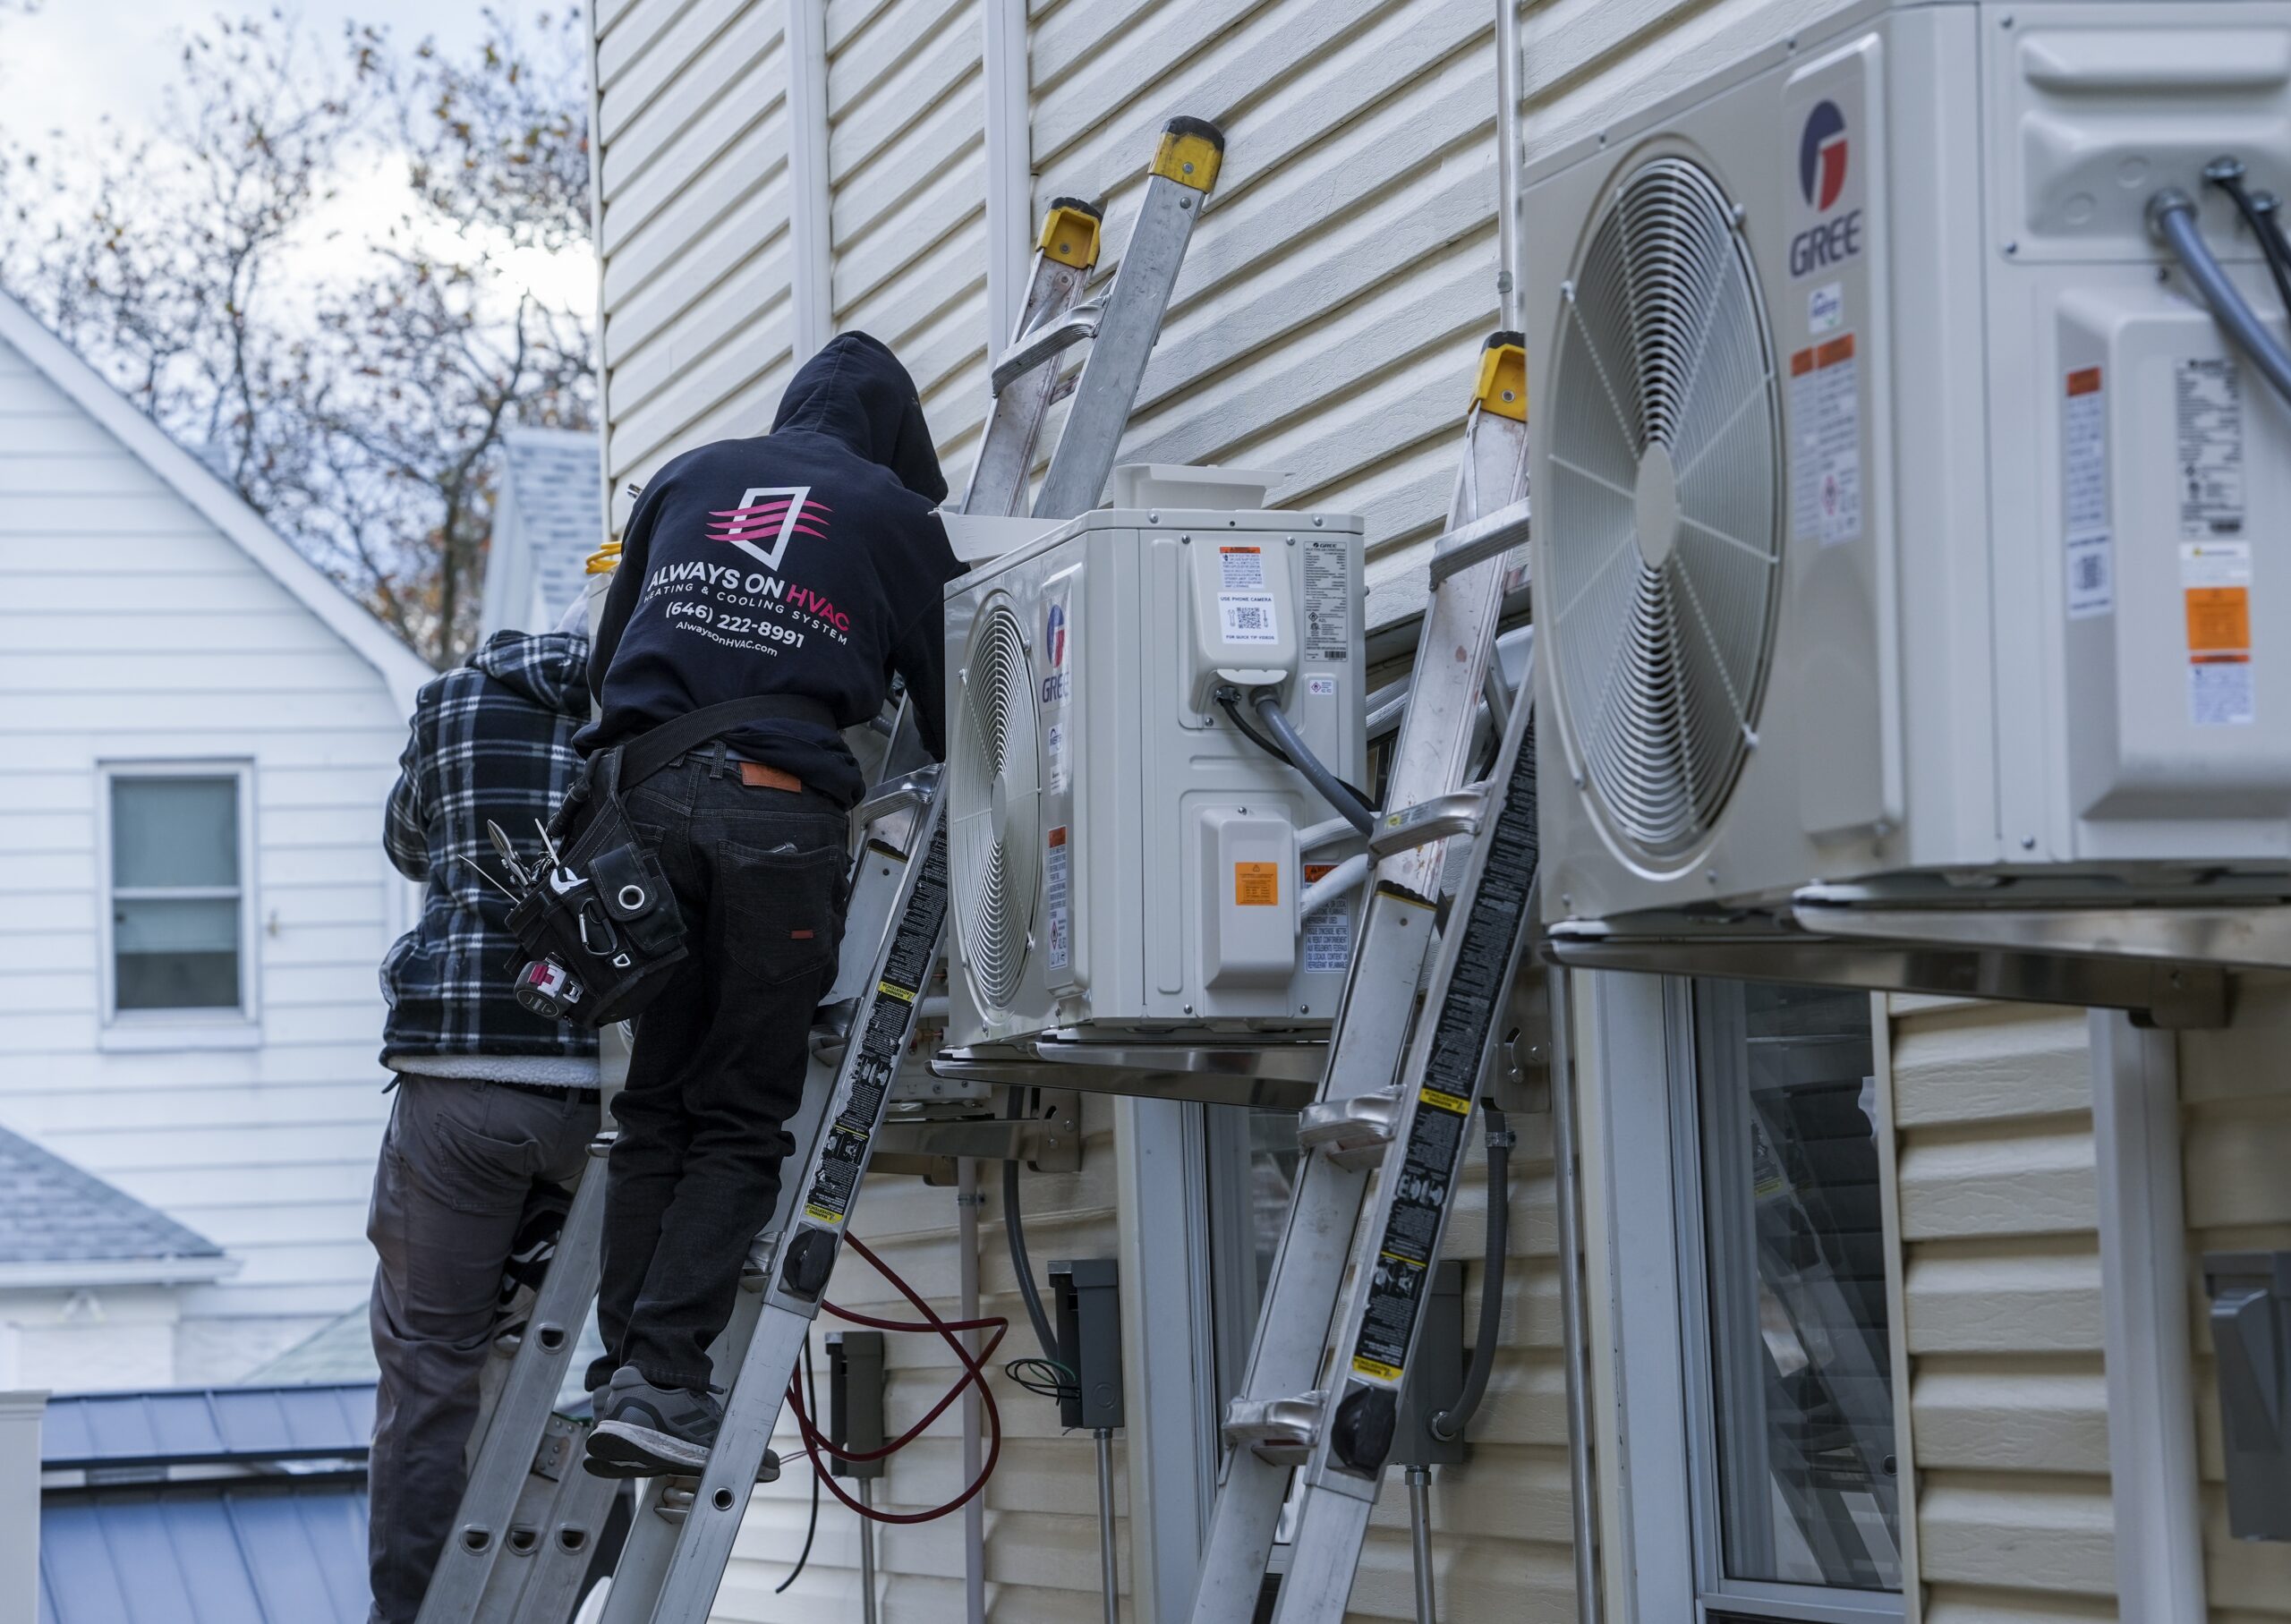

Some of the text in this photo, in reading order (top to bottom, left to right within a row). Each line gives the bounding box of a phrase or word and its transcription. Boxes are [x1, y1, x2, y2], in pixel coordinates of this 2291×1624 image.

[1791, 208, 1862, 277] GREE
[643, 583, 847, 645] HEATING & COOLING SYSTEM
[647, 561, 849, 632] ALWAYS ON HVAC
[666, 601, 805, 648] (646) 222-8991
[676, 621, 778, 657] AlwaysOnHVAC.com
[1043, 672, 1069, 703] GREE
